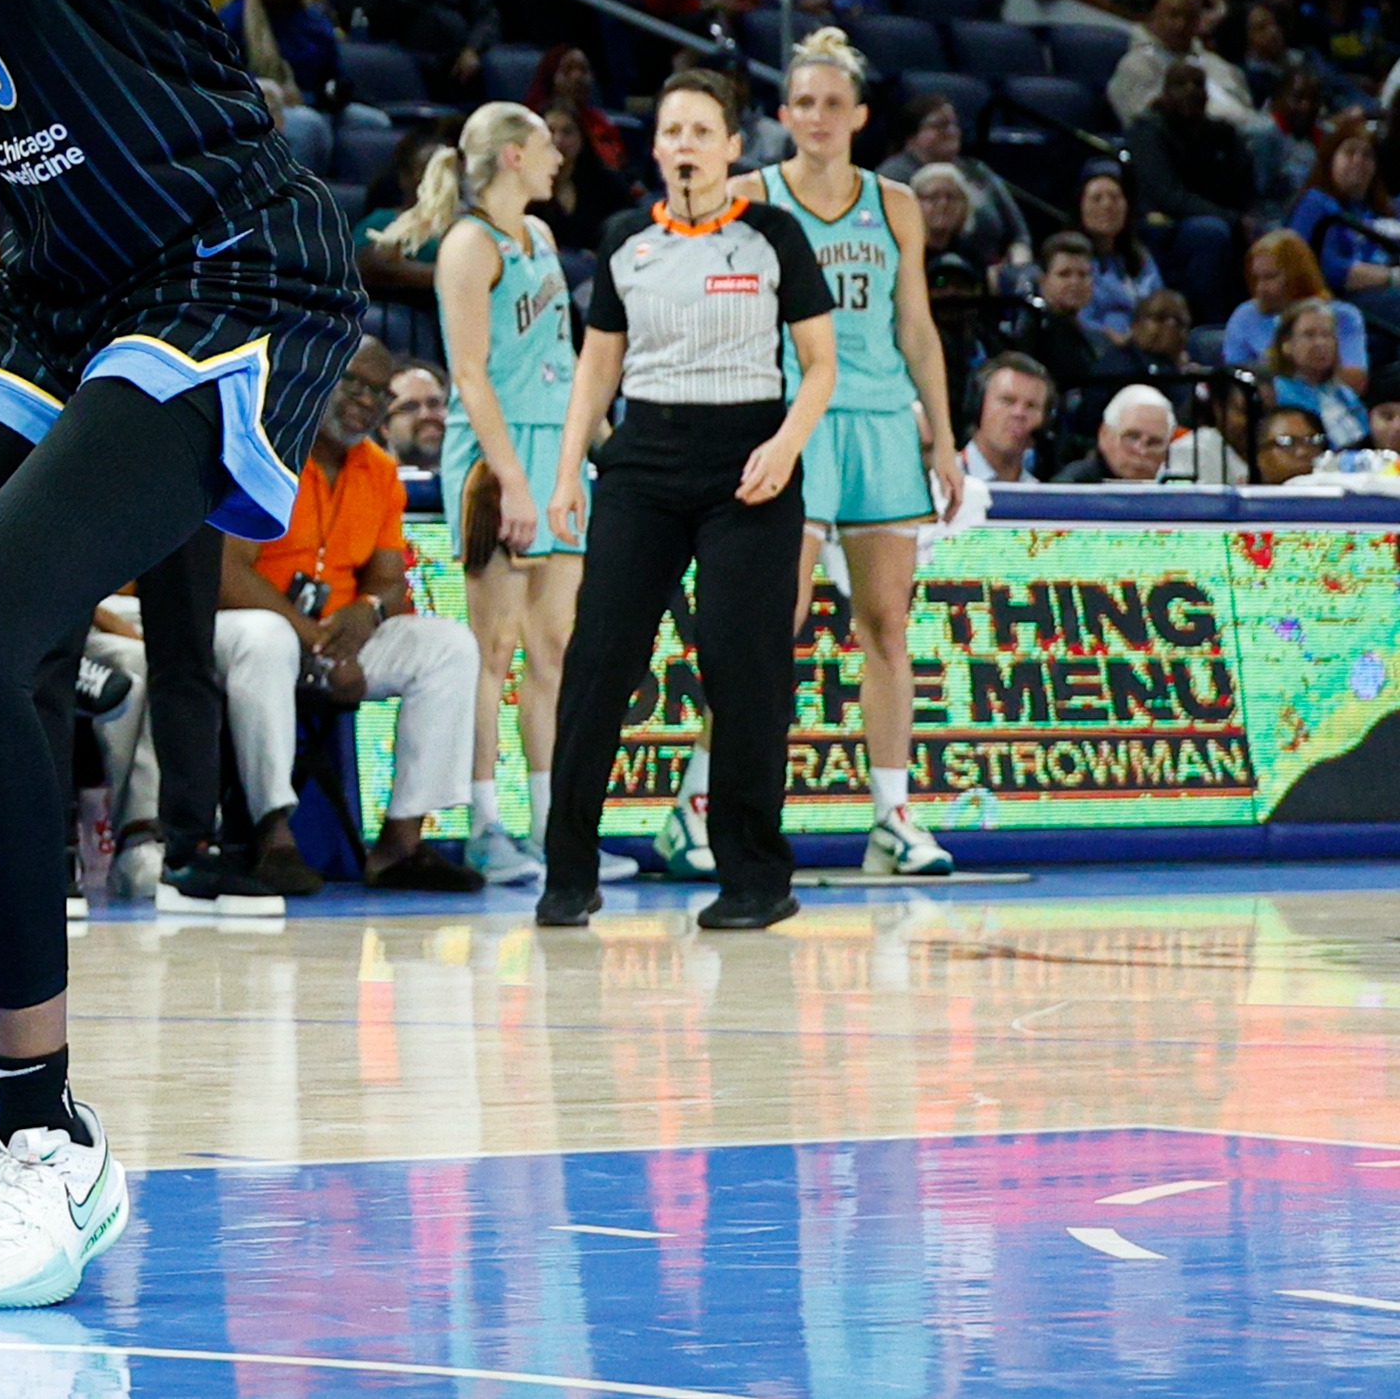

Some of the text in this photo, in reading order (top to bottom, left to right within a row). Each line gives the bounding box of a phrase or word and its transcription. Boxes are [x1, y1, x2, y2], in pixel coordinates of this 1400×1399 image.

[834, 272, 869, 309] 13
[970, 660, 1238, 724] MENU
[942, 738, 1249, 788] STROWMAN
